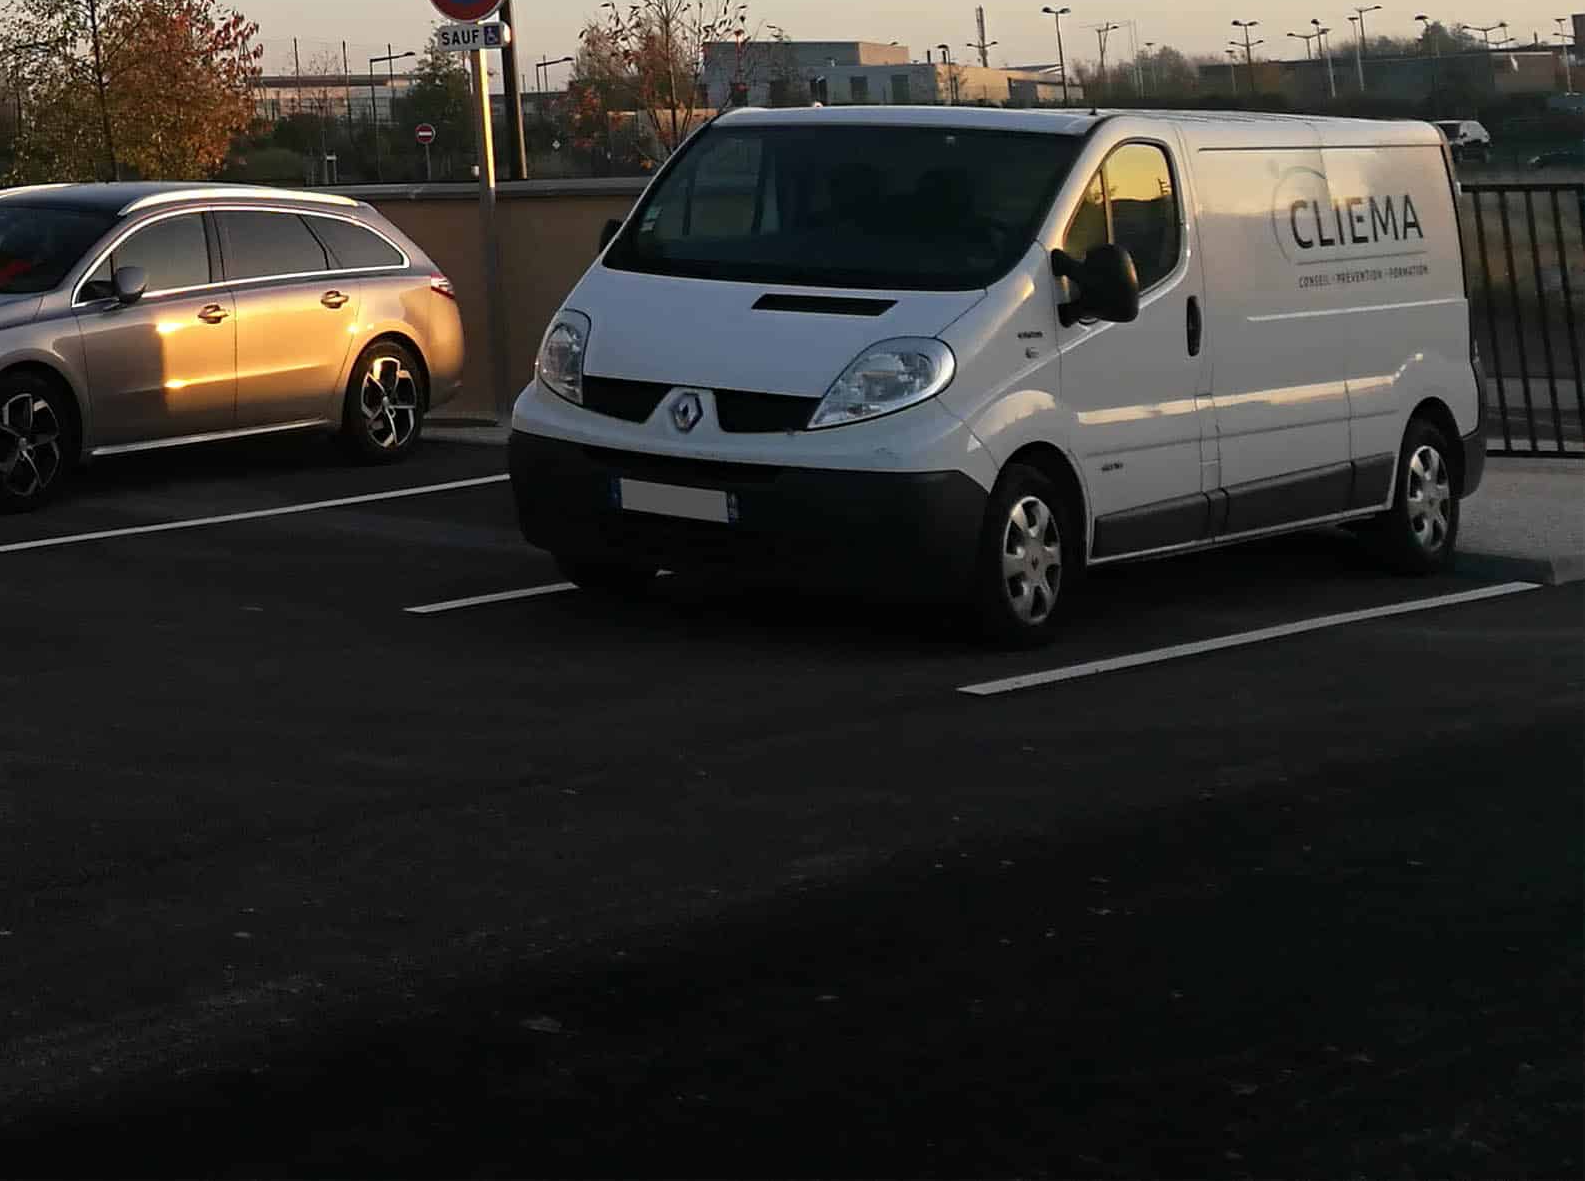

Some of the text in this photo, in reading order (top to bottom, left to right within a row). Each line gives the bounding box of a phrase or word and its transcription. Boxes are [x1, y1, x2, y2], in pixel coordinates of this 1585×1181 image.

[441, 29, 480, 46] SAUF
[1290, 194, 1424, 249] CLIEMA
[1299, 274, 1332, 288] CONSEIL
